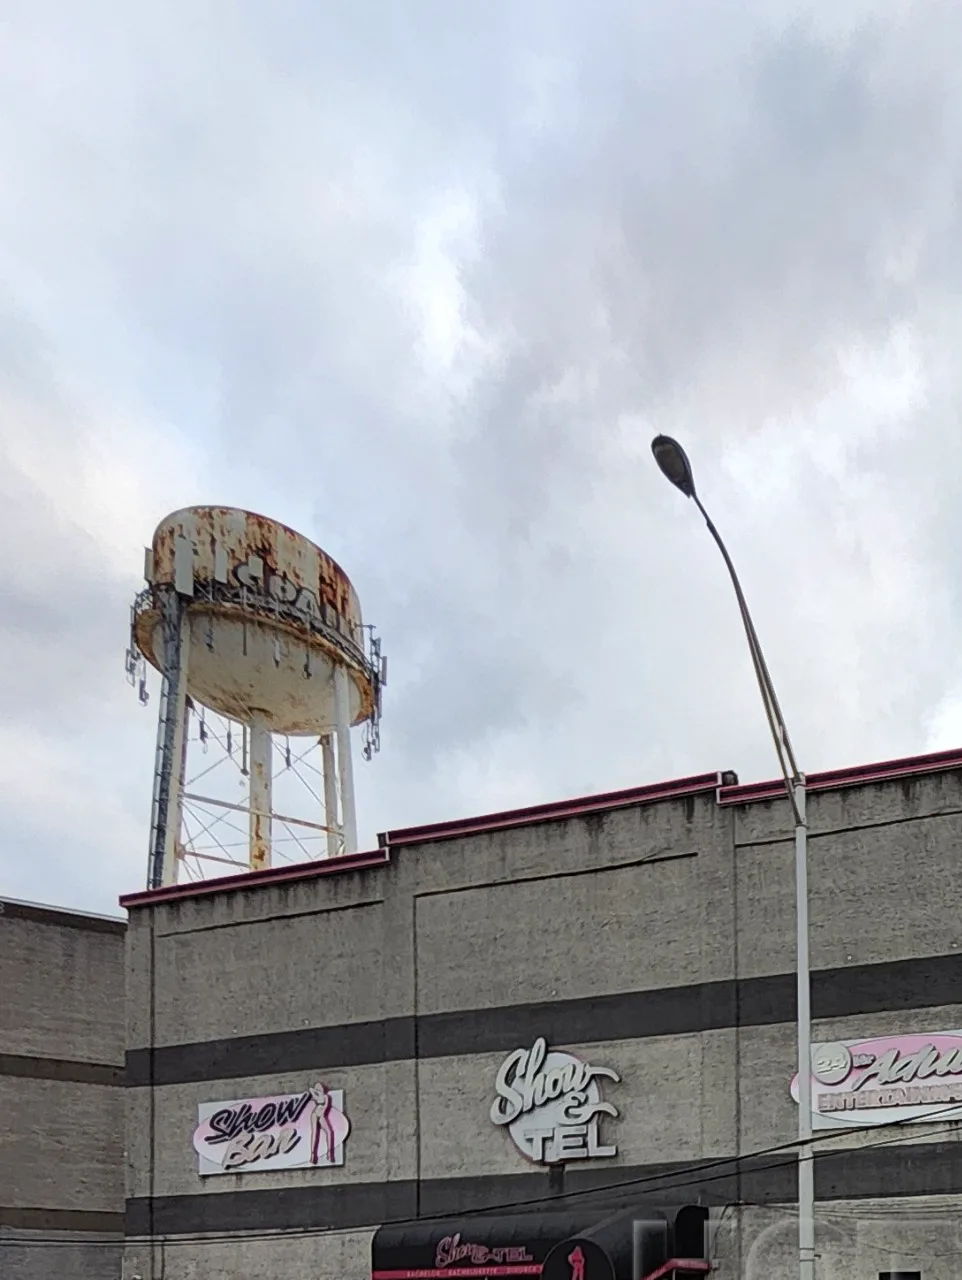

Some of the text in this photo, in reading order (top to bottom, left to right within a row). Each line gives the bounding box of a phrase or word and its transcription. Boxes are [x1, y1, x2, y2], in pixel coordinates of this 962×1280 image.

[490, 1037, 622, 1125] Show
[816, 1053, 848, 1074] 24
[556, 1090, 619, 1126] &
[523, 1121, 617, 1162] TEL
